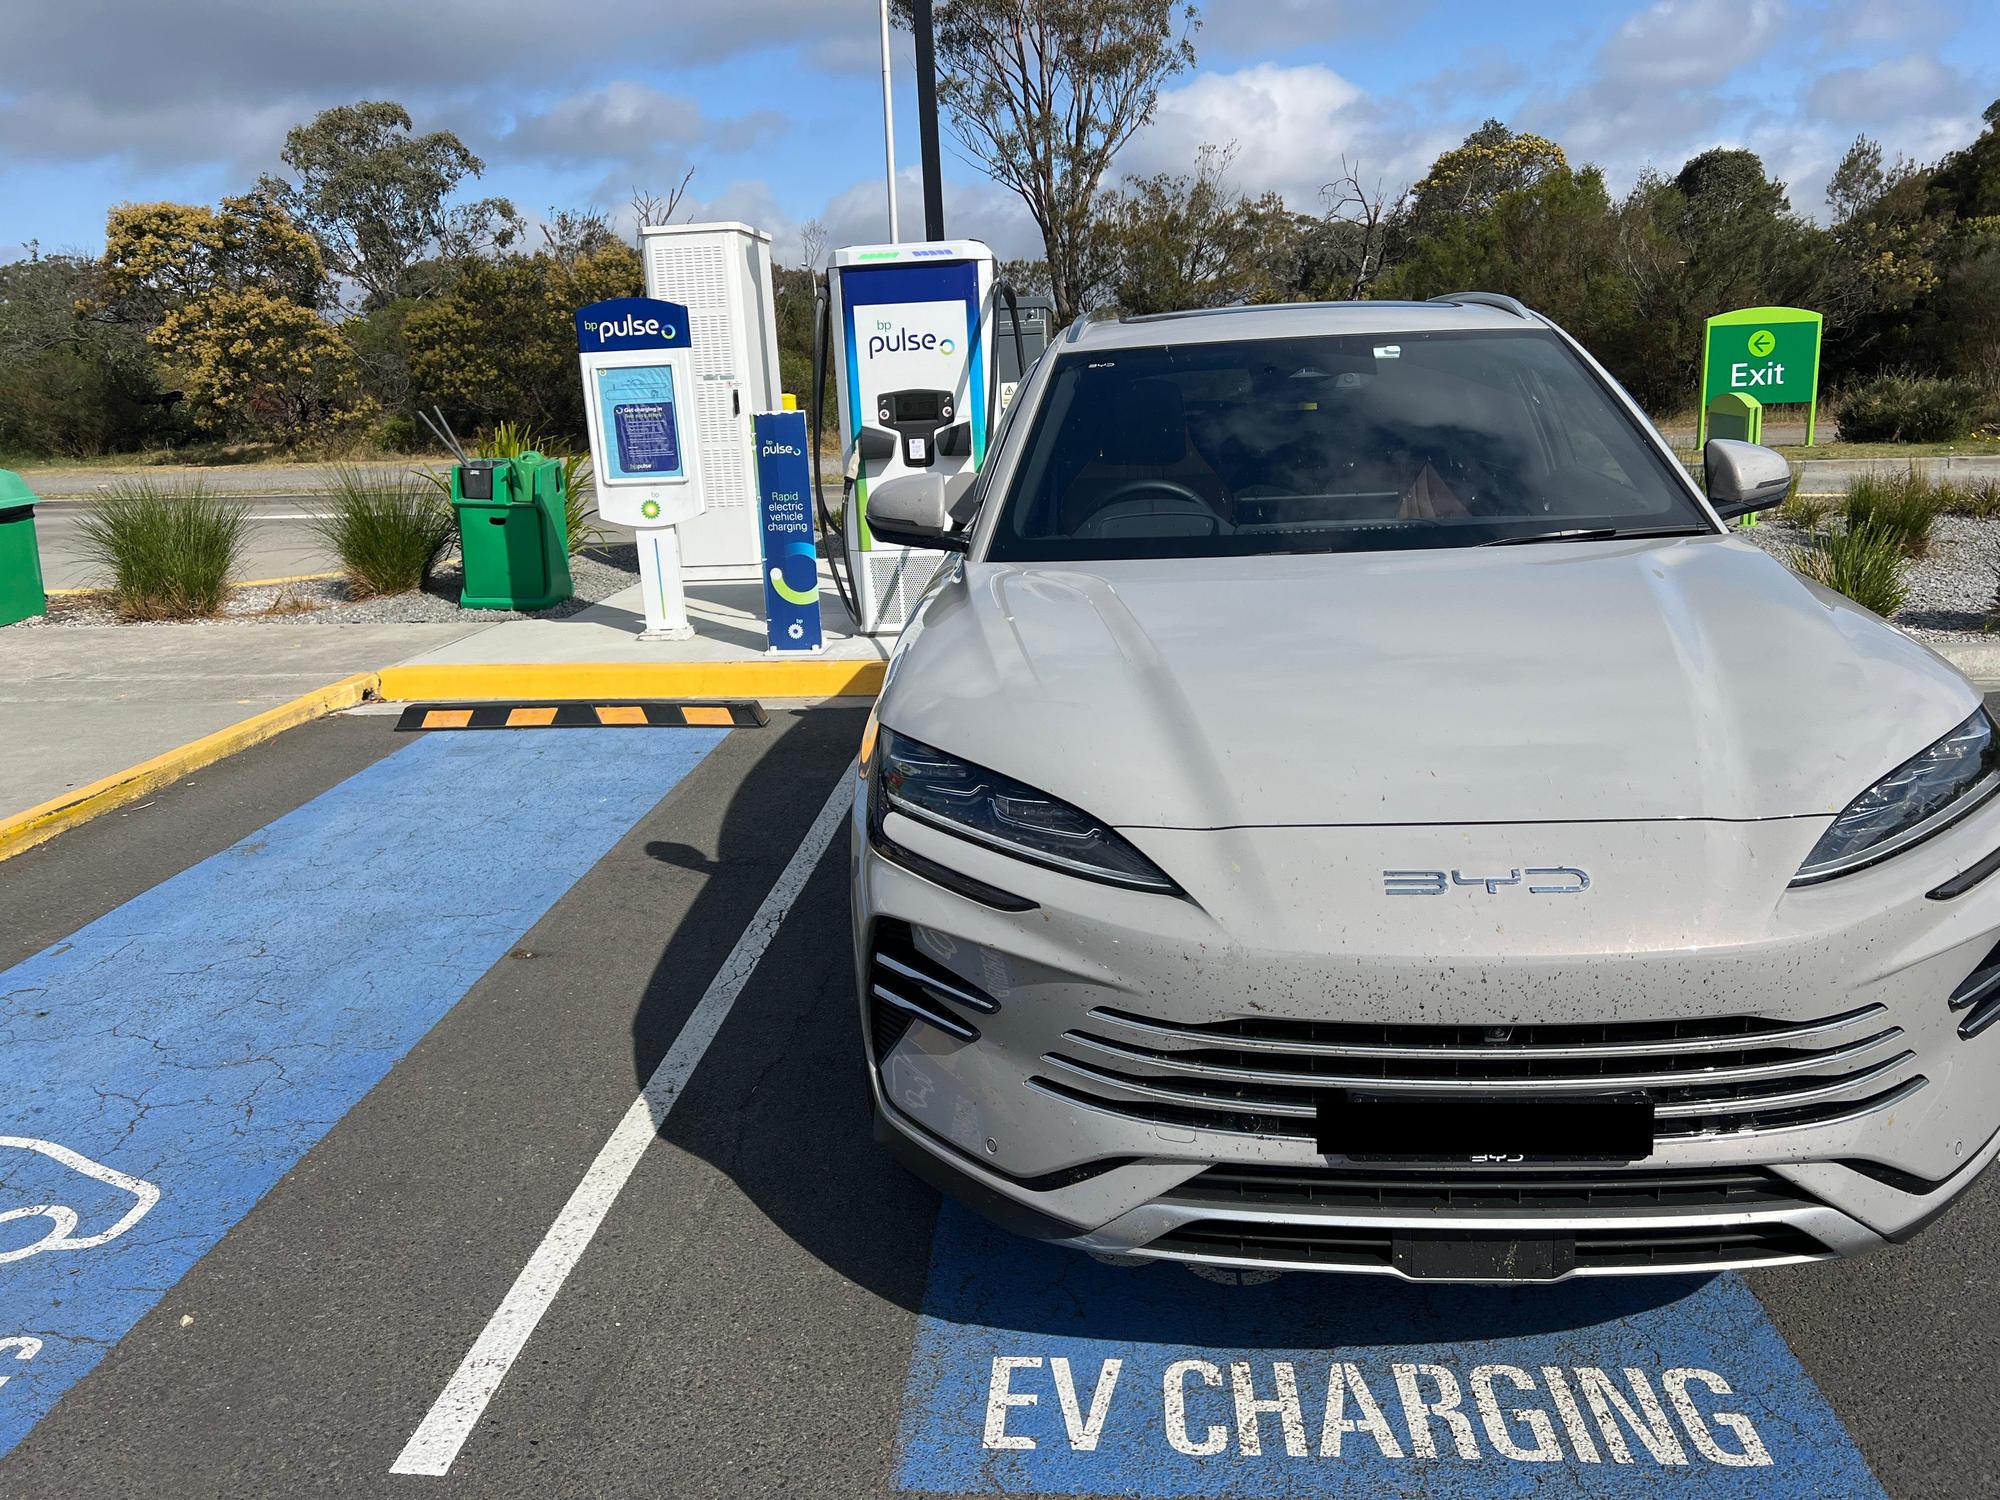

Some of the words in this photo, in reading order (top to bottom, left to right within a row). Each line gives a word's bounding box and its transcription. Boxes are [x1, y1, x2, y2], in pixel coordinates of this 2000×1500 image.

[584, 320, 598, 332] bp
[599, 313, 660, 343] pulse
[876, 319, 892, 332] bp
[869, 327, 937, 360] pulse
[1731, 361, 1785, 387] Exit
[762, 443, 793, 457] pulse
[771, 491, 799, 503] Rapid
[768, 502, 804, 512] electric
[770, 511, 803, 521] vehicle
[767, 521, 808, 533] charging
[1383, 866, 1591, 896] BYD
[983, 1356, 1122, 1452] EV
[1161, 1358, 1775, 1469] CHARGING
